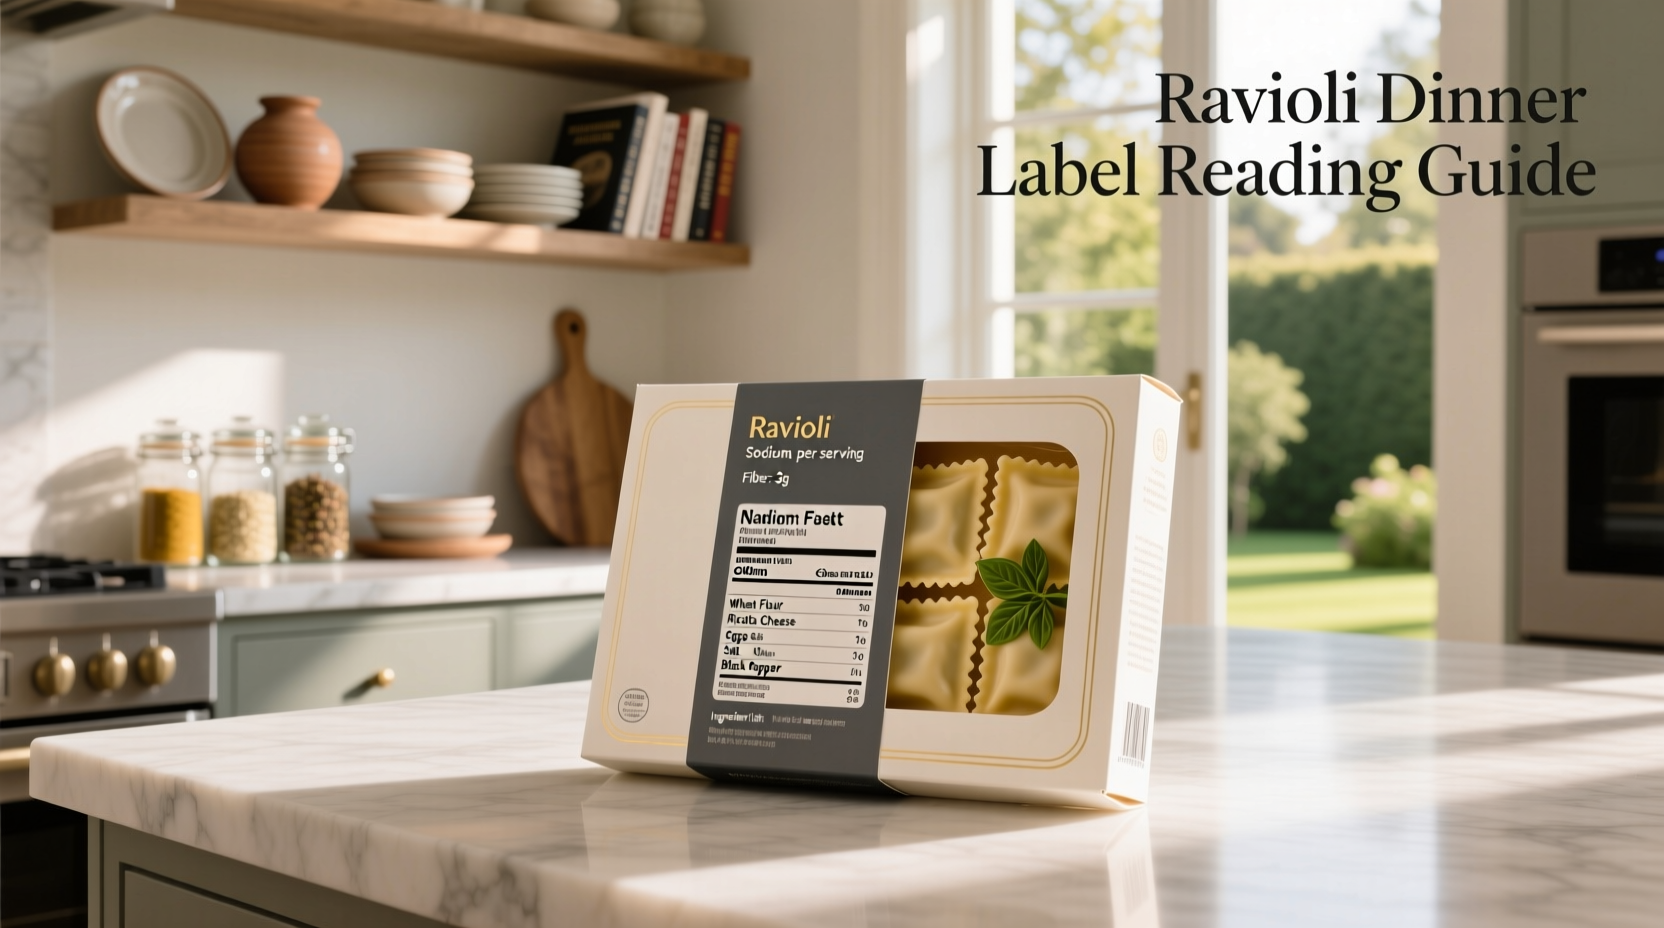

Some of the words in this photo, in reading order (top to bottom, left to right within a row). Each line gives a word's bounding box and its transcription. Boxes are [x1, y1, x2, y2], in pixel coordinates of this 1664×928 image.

[749, 415, 832, 439] Ravioli
[745, 446, 792, 460] Sodium
[796, 448, 817, 463] per
[819, 447, 864, 463] serving
[760, 614, 797, 627] Cheese
